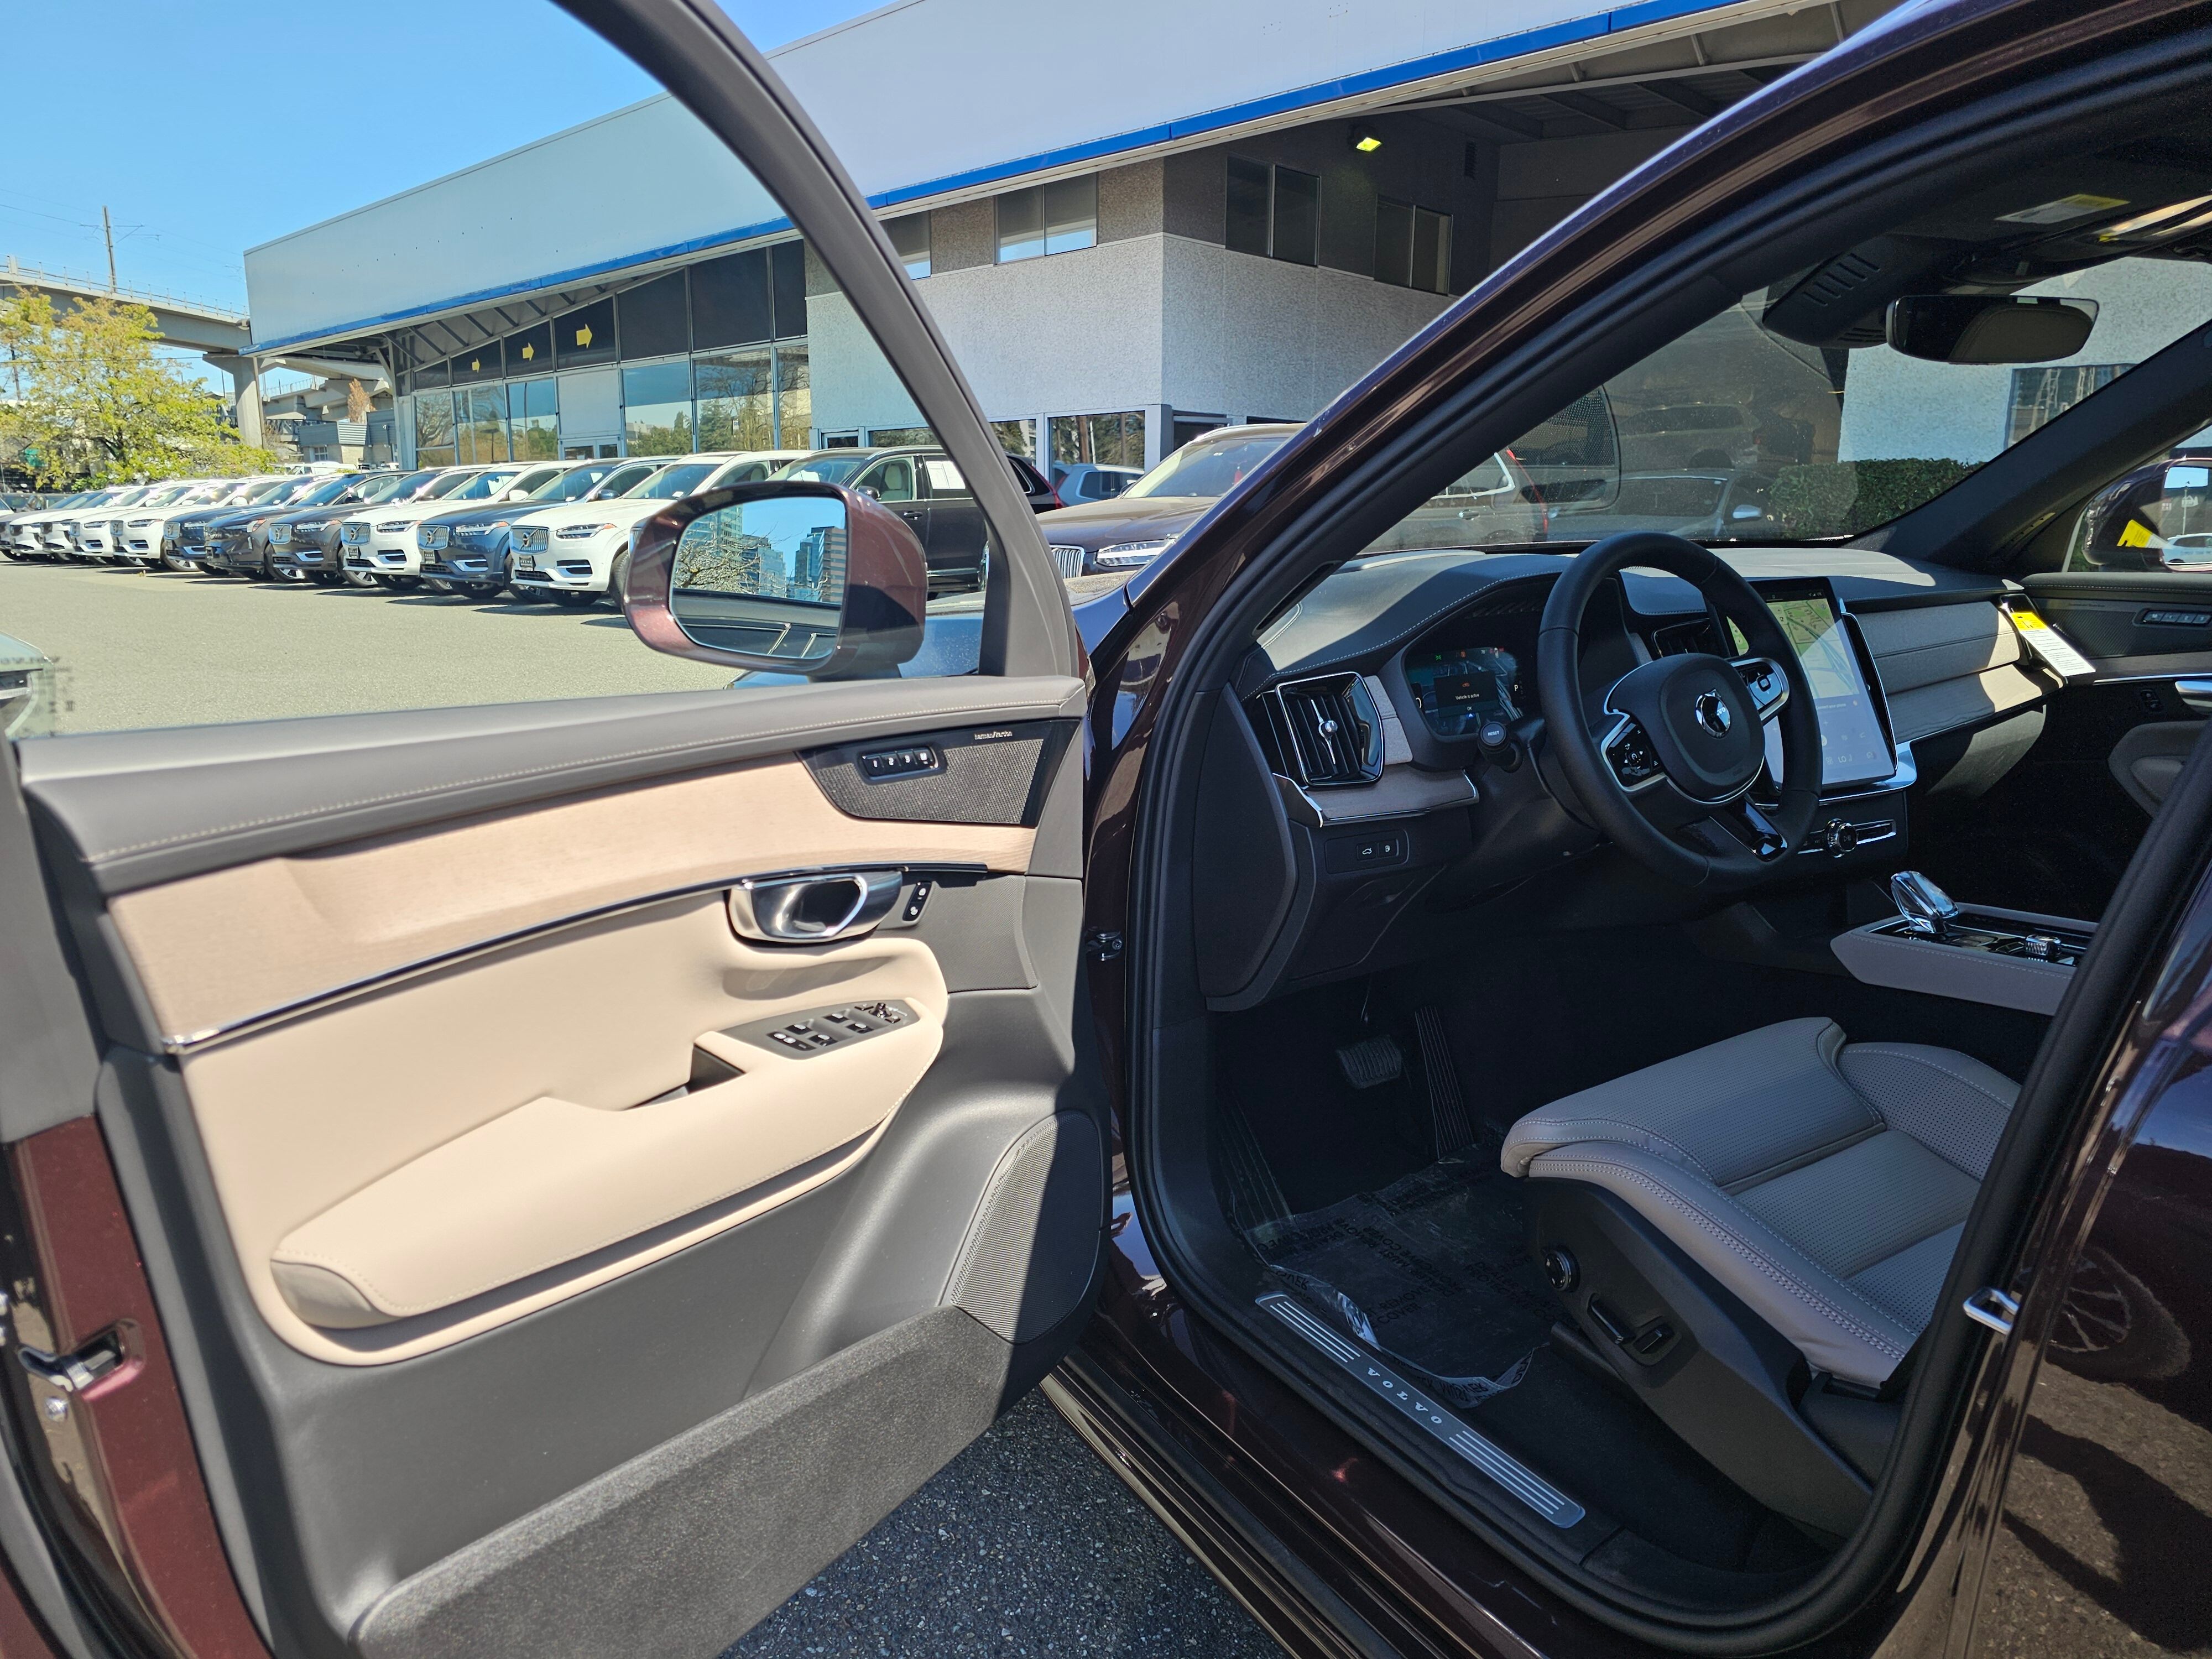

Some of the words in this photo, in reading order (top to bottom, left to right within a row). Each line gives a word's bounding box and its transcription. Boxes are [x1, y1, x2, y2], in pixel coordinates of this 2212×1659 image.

[1362, 1226, 1402, 1251] COVER
[1376, 1302, 1423, 1324] COVER
[1366, 1367, 1442, 1424] VOLVO
